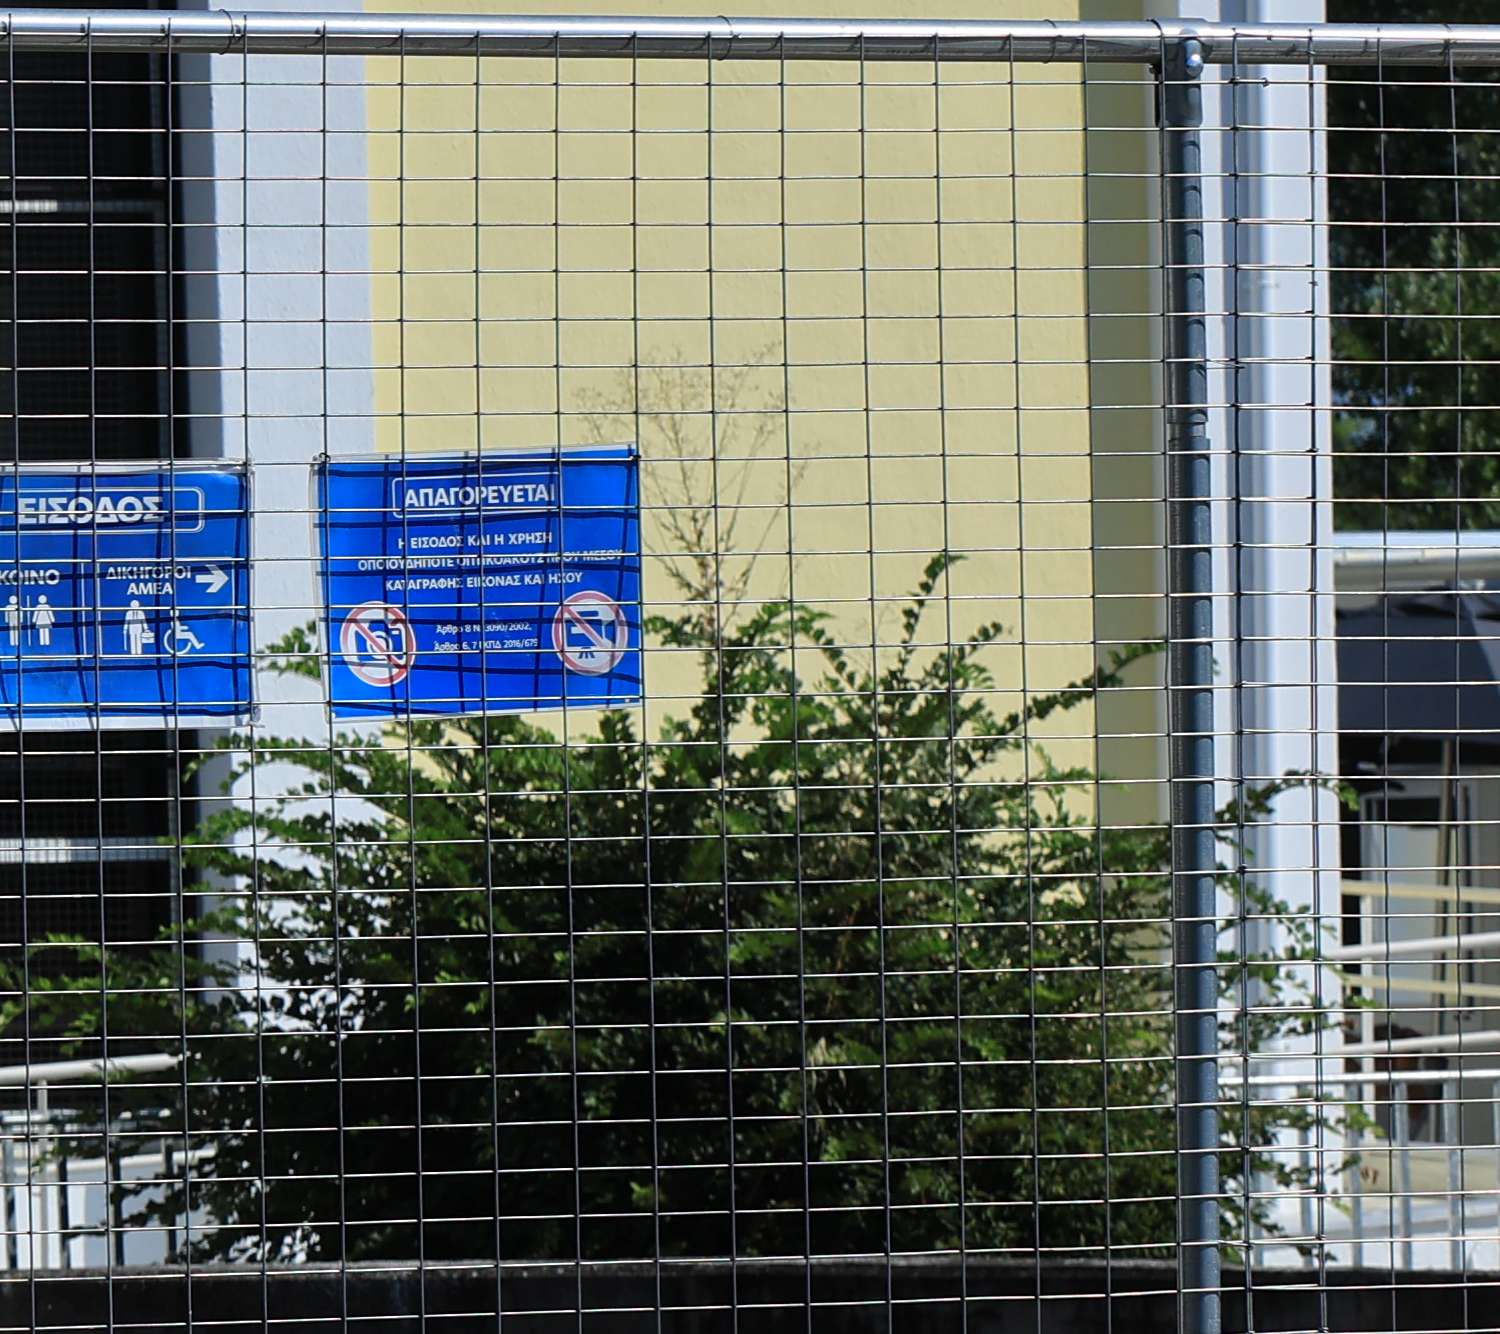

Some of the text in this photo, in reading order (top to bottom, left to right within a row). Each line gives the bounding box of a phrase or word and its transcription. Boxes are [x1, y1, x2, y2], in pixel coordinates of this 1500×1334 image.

[404, 483, 556, 507] ΑΠΑΓΟΡΕΥΕΤΑΙ
[16, 496, 164, 525] ΕΙΣΟΔΟΣ
[410, 535, 464, 549] ΕΙΣΟΔΟΣ
[467, 534, 491, 548] ΚΑΙ
[494, 534, 504, 546] Η
[508, 531, 553, 545] ΧΡΗΣΗ
[105, 565, 192, 580] ΔΙΚΗΓΟΡΟΙ
[127, 582, 173, 595] ΑΜΕΑ
[466, 575, 522, 588] ΕΙΚΟΝΑΣ
